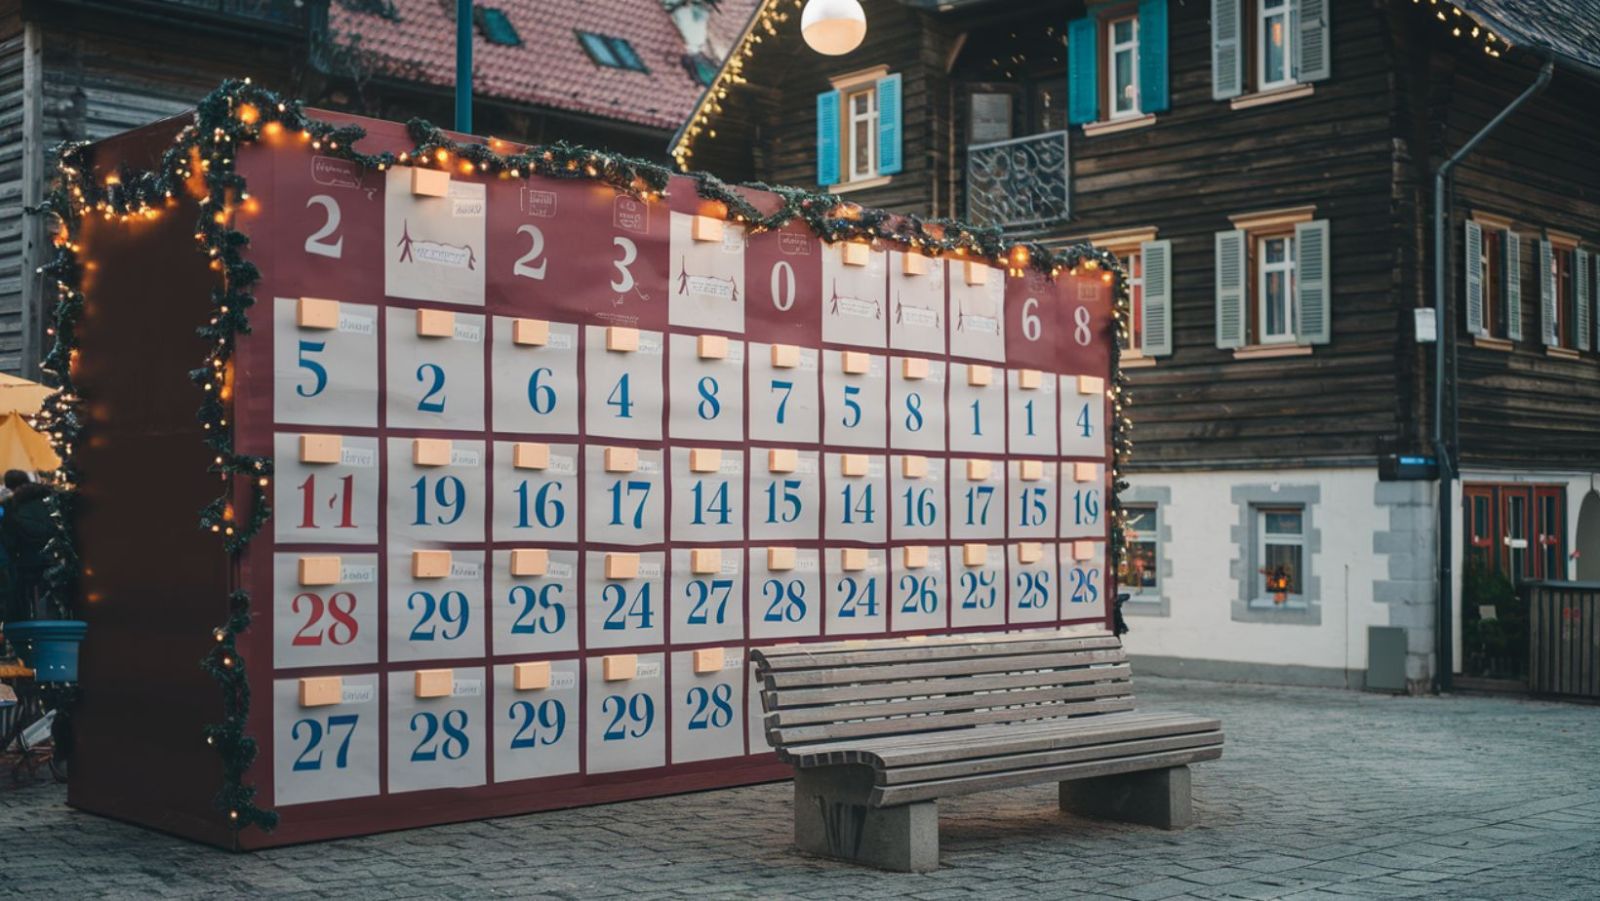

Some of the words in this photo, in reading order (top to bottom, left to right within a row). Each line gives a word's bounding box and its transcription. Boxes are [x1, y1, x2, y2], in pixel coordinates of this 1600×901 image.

[305, 195, 342, 258] 2
[514, 225, 547, 279] 2
[611, 237, 638, 293] 3
[771, 261, 796, 311] 0
[1022, 298, 1041, 341] 6
[1074, 306, 1091, 345] 8
[296, 339, 328, 397] 5
[416, 363, 447, 414] 2
[527, 368, 557, 415] 6
[606, 372, 633, 419] 4
[697, 376, 721, 420] 8
[770, 379, 794, 426] 7
[842, 385, 862, 427] 5
[904, 394, 923, 432] 8
[971, 399, 983, 436] 1
[1025, 400, 1035, 437] 1
[1077, 403, 1093, 438] 4
[413, 476, 466, 526] 19
[513, 479, 565, 528] 16
[607, 480, 652, 530] 17
[689, 480, 733, 525] 14
[764, 480, 802, 524] 15
[842, 483, 874, 525] 14
[902, 487, 937, 527] 16
[966, 485, 995, 526] 17
[1019, 486, 1047, 527] 15
[407, 591, 470, 641] 29
[602, 581, 653, 630] 24
[685, 580, 733, 625] 27
[763, 579, 807, 622] 28
[837, 576, 879, 618] 24
[899, 575, 938, 613] 26
[292, 592, 359, 646] 28
[509, 700, 566, 749] 29
[603, 693, 654, 741] 29
[687, 683, 733, 730] 28
[291, 714, 359, 772] 27
[409, 710, 469, 762] 28
